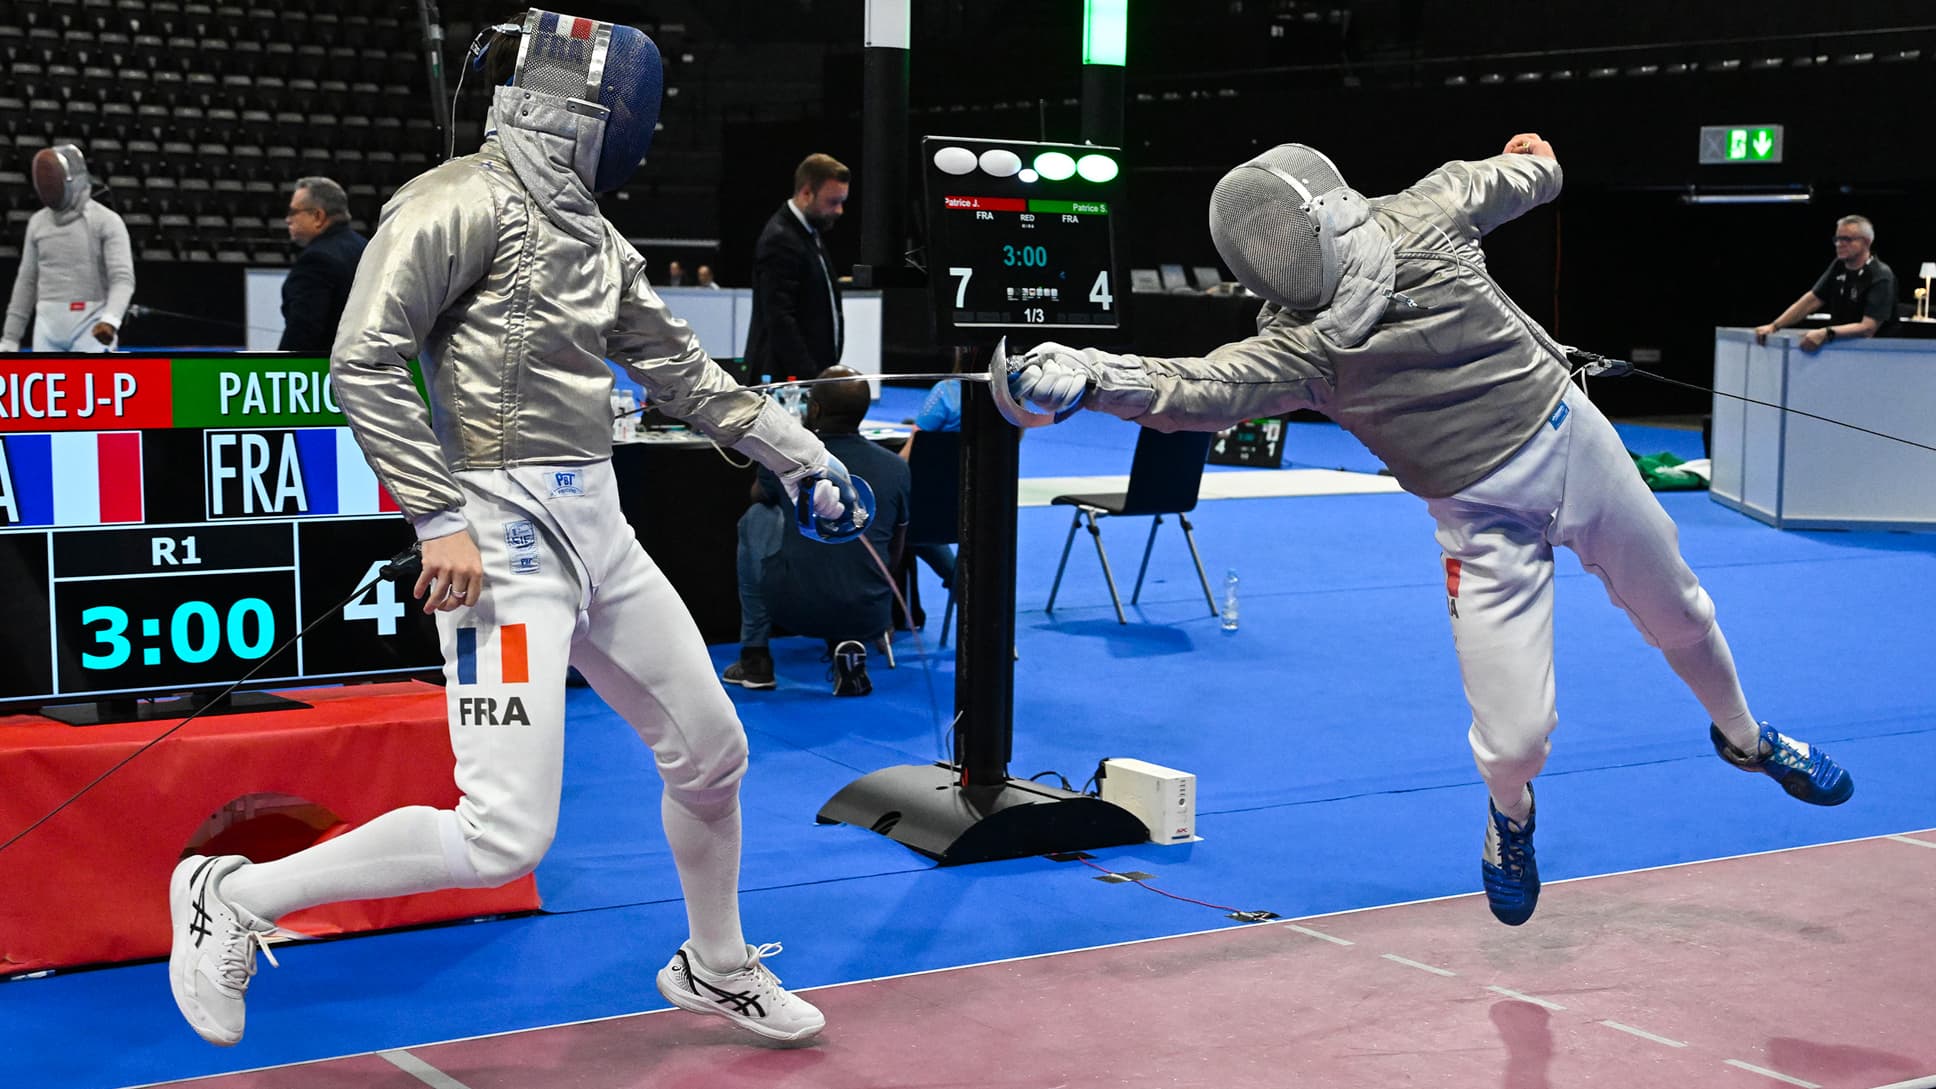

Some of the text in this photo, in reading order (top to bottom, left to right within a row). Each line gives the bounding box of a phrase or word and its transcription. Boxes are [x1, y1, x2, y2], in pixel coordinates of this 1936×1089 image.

[976, 211, 994, 220] FRA
[1020, 214, 1035, 222] RED
[1062, 214, 1079, 223] FRA
[1073, 203, 1098, 212] Patrice
[1003, 245, 1048, 267] 3:00
[949, 267, 973, 308] 7
[1089, 270, 1113, 311] 4
[1024, 308, 1045, 322] 1/3
[77, 372, 137, 417] J-P
[211, 432, 308, 515] FRA
[151, 536, 201, 566] R1
[343, 560, 405, 636] 4
[81, 597, 275, 670] 3:00
[459, 696, 531, 726] FRA
